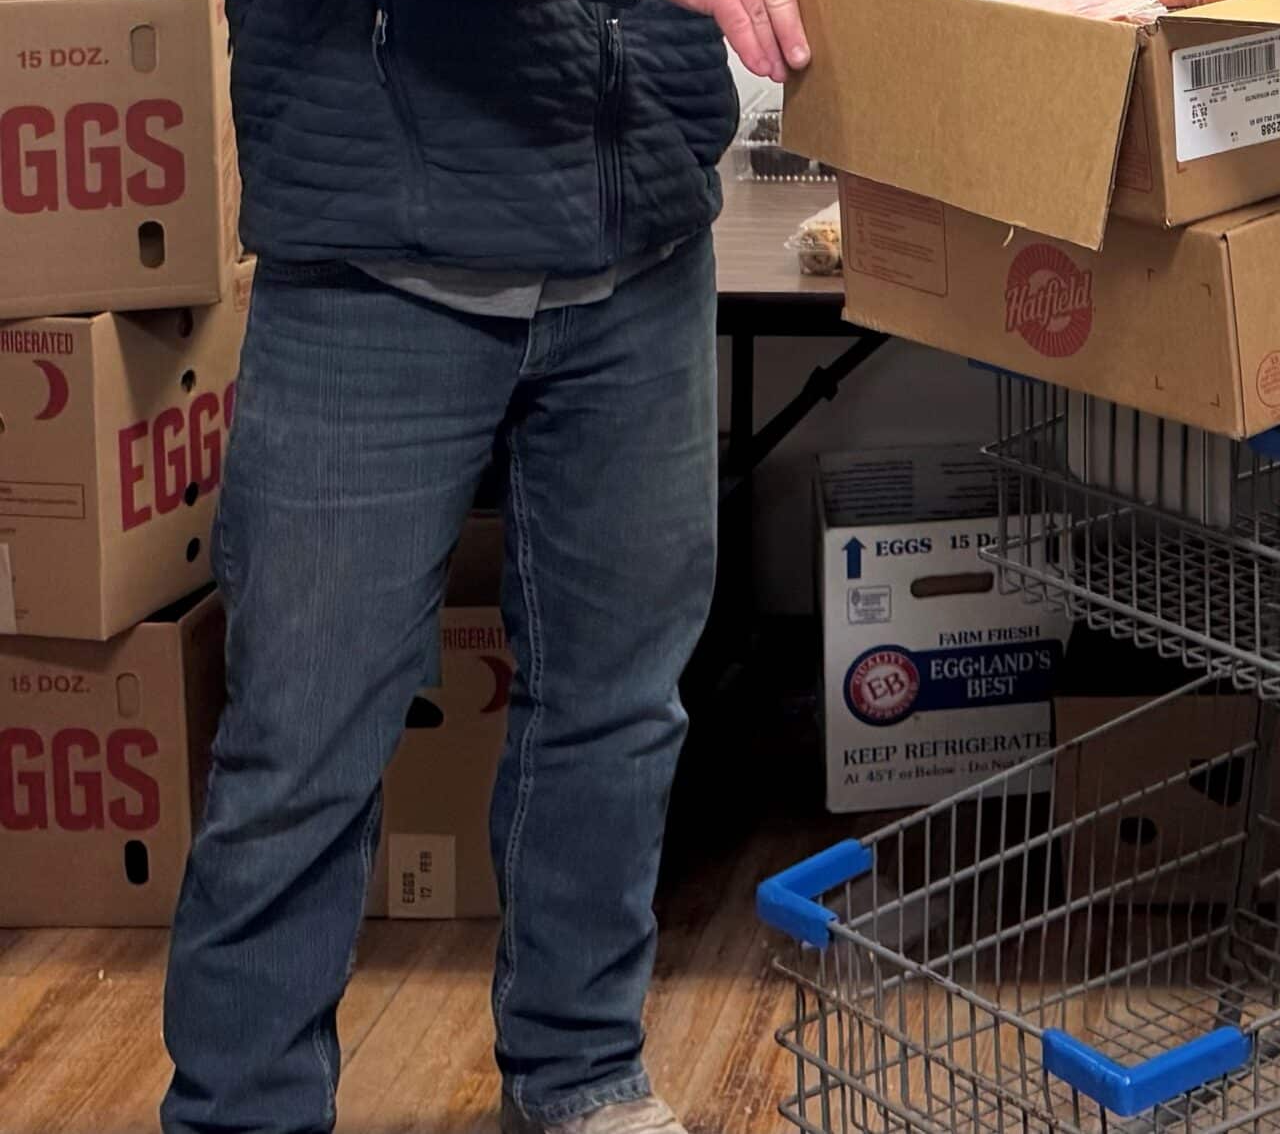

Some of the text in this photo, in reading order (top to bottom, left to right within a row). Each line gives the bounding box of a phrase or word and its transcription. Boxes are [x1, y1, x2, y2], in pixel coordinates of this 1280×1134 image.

[17, 47, 110, 69] 15 DOZ.
[1005, 272, 1093, 332] Hatfield
[875, 537, 932, 557] EGGS
[950, 535, 970, 549] 15
[939, 626, 1040, 646] FARM FRESH
[11, 675, 91, 693] 15 DOZ.
[867, 672, 905, 700] EB
[967, 675, 1017, 699] BEST
[843, 732, 1050, 768] KEEP REFRIGERATE
